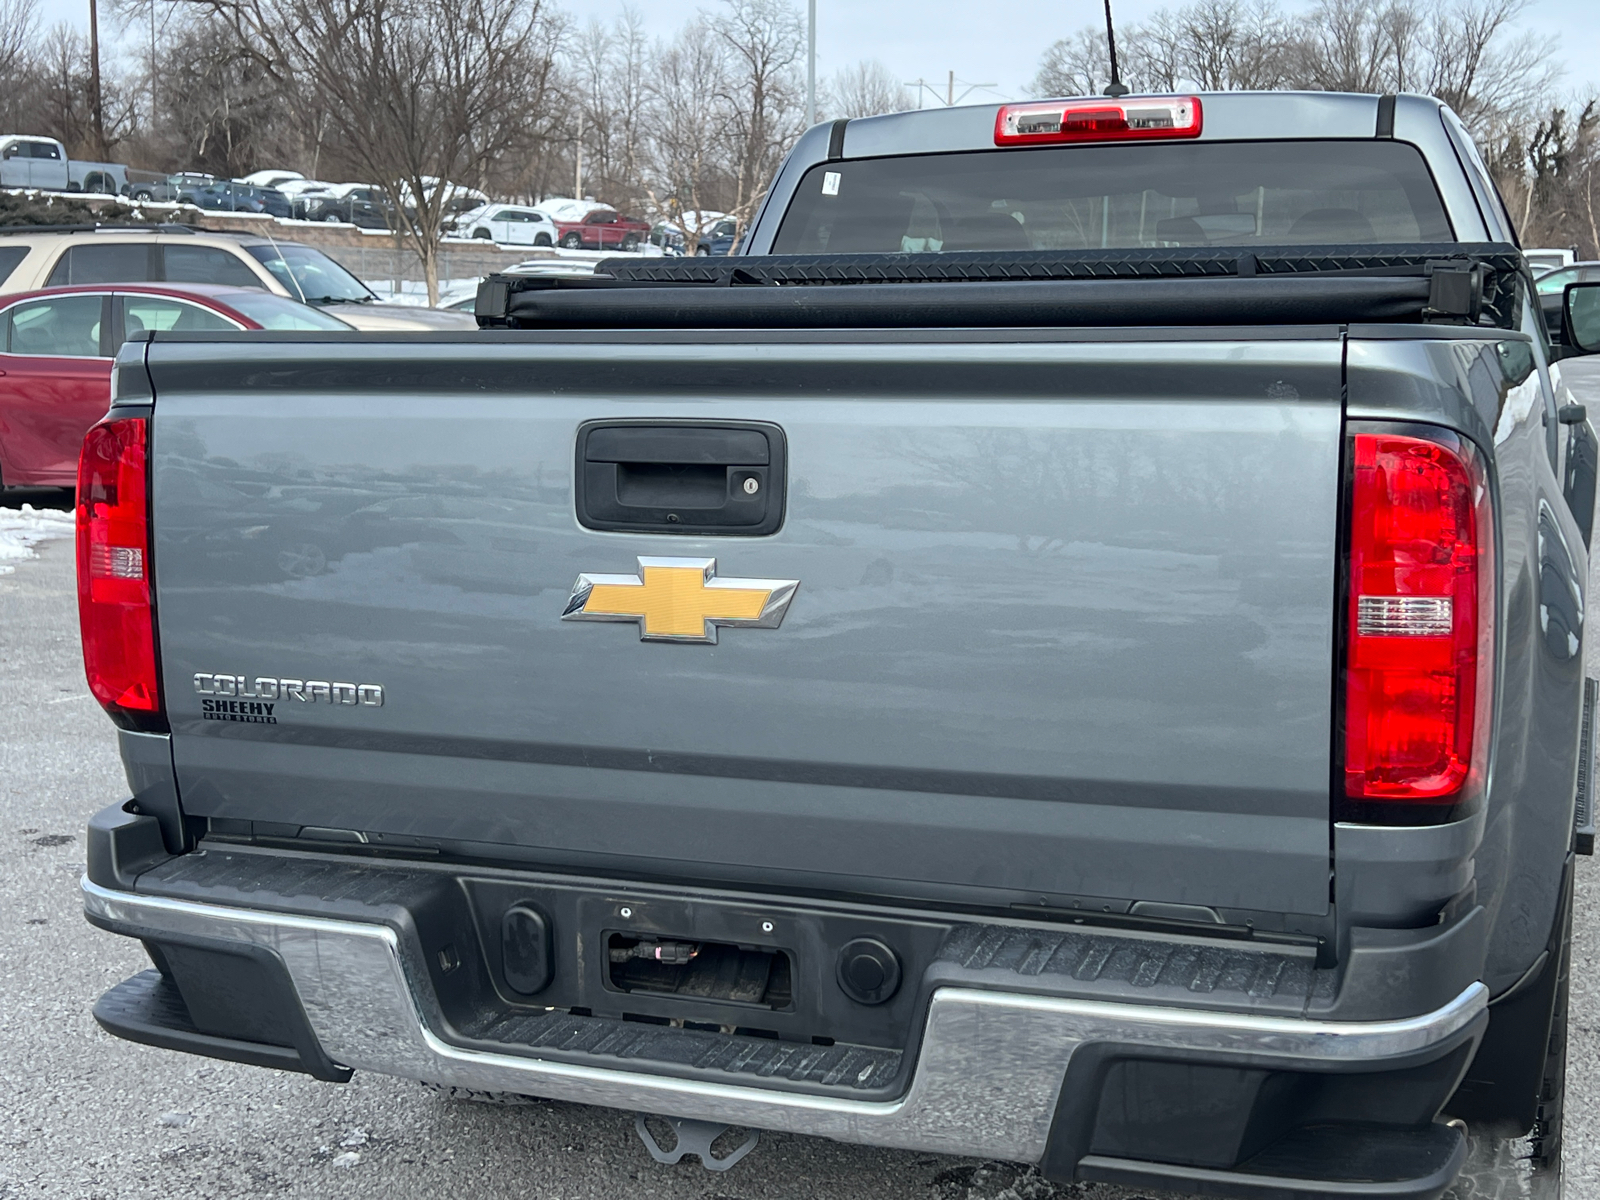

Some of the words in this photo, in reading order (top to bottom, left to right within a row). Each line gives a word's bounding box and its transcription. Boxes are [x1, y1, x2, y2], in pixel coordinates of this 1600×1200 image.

[193, 672, 383, 707] COLORADO
[202, 699, 275, 716] SHEEHY
[205, 712, 231, 721] AUTO
